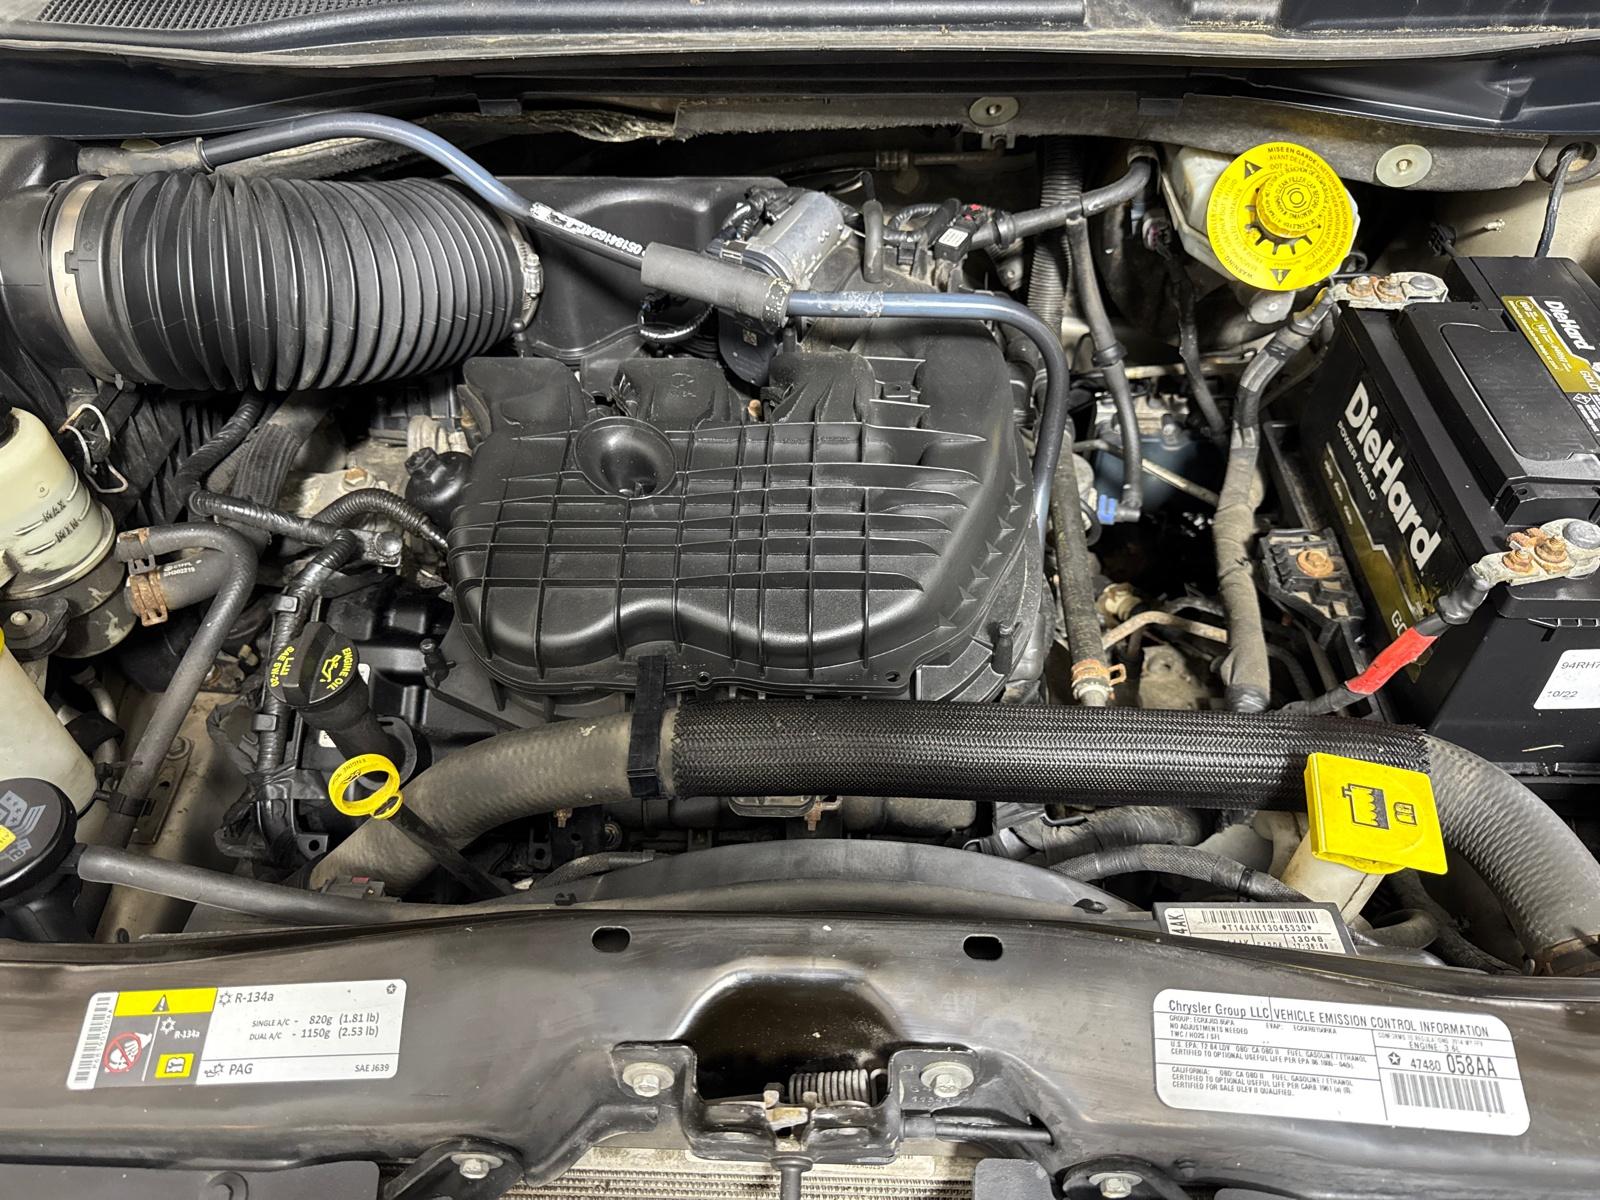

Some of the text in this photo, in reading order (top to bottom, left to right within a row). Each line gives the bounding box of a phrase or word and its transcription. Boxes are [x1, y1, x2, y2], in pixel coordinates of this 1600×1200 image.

[1295, 149, 1318, 164] GARDE
[1544, 300, 1596, 350] DieHard
[1337, 420, 1358, 460] POWER
[1355, 461, 1378, 500] AHEAD
[1344, 380, 1442, 571] DieHard
[326, 647, 354, 691] ENGINE OIL
[235, 992, 274, 1004] R-134a
[276, 1018, 290, 1026] A/C
[310, 1015, 333, 1026] 820g
[339, 1013, 363, 1025] (1.81
[366, 1012, 380, 1024] lb)
[1168, 1000, 1489, 1037] Chrysler Group LLC VEHICLE EMISSION CONTROL INFORMATION
[174, 1029, 200, 1040] R-134a
[268, 1032, 282, 1040] A/C
[301, 1028, 331, 1039] 1150g
[338, 1027, 363, 1039] (2.53
[366, 1026, 379, 1038] lb)
[1180, 1023, 1223, 1033] ADJUSTMENTS
[229, 1063, 254, 1076] PAG
[354, 1063, 390, 1072] SAE J639
[1410, 1053, 1498, 1077] 47480 058AA
